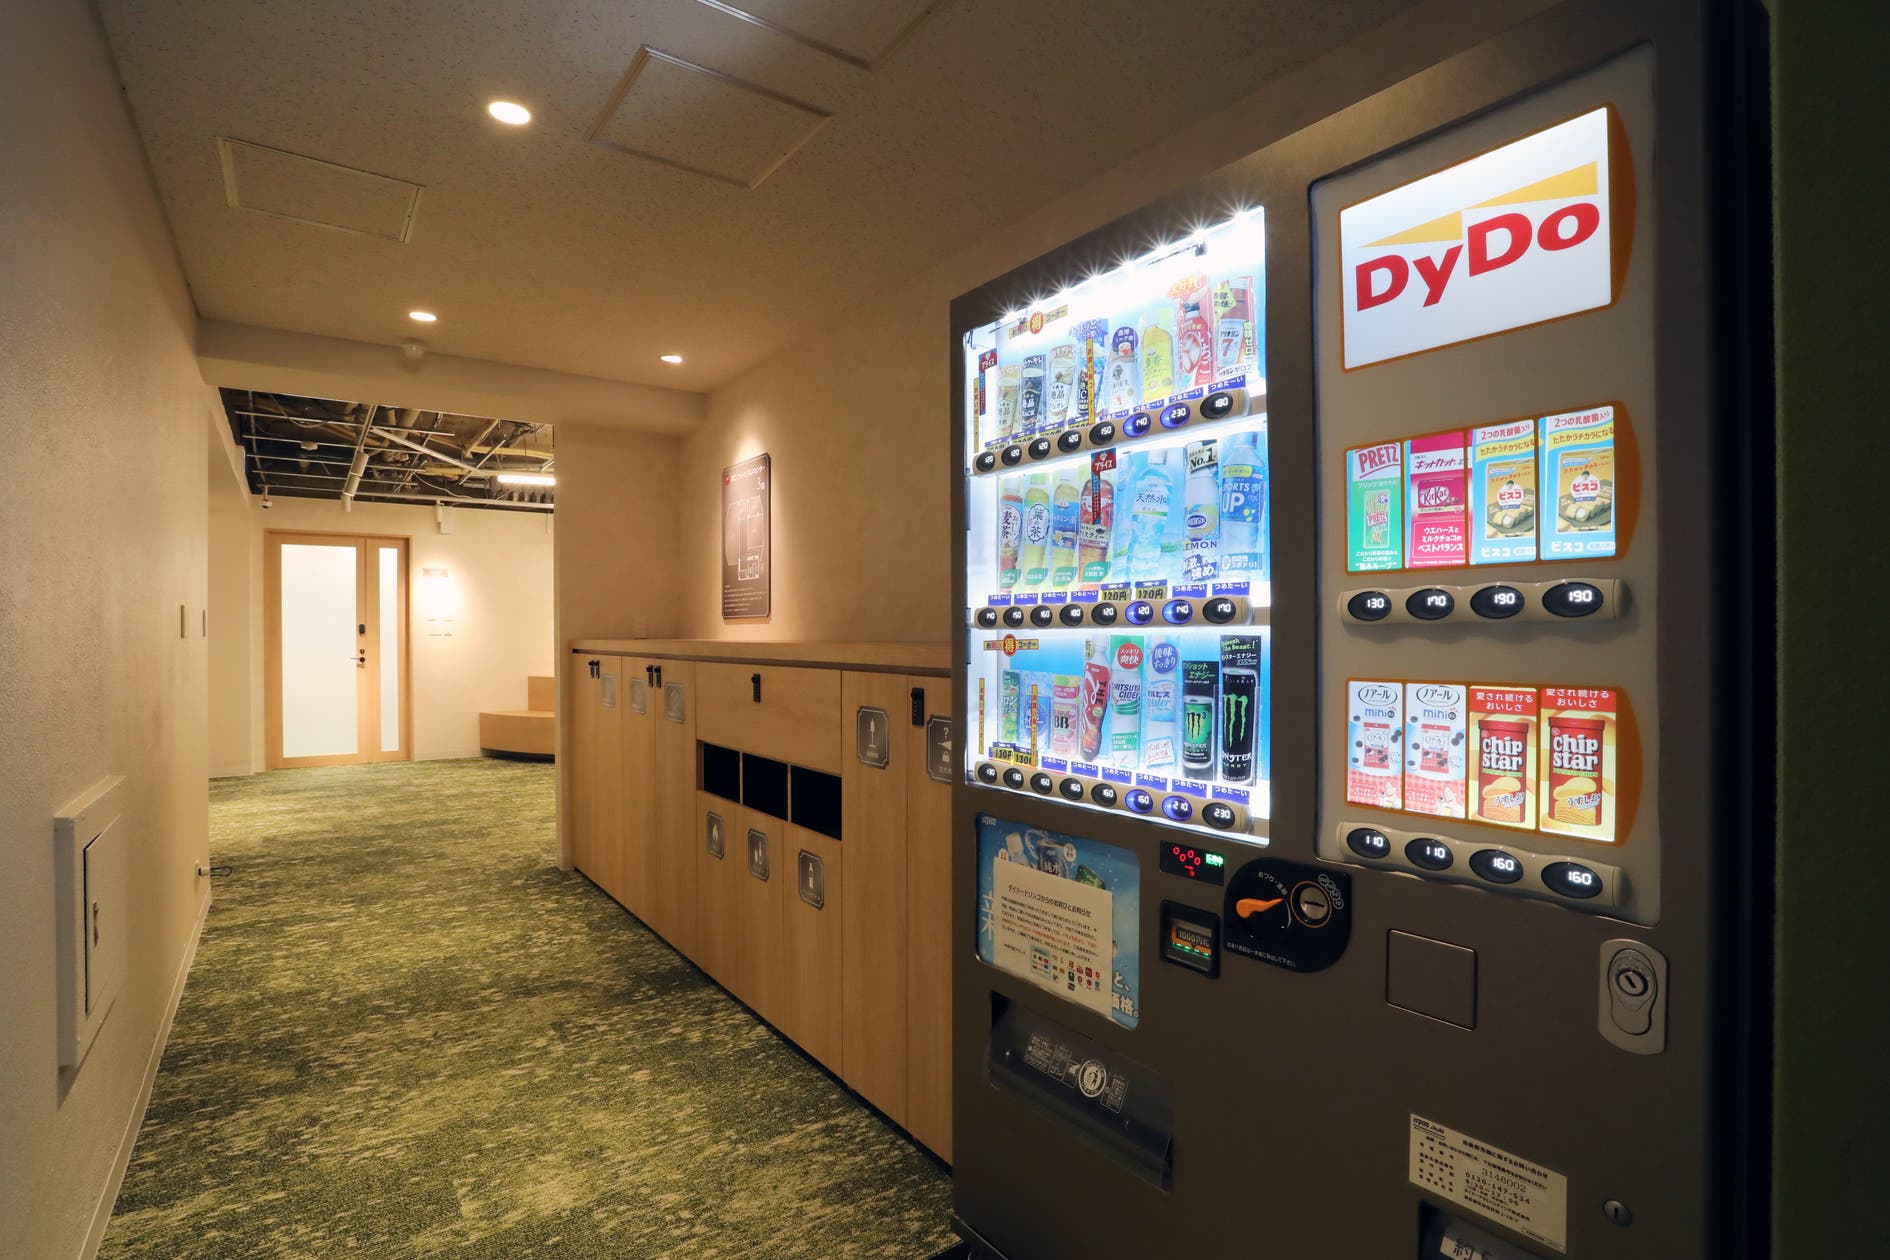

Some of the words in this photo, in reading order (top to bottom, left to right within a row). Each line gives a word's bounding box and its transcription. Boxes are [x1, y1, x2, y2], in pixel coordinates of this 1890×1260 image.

[1355, 202, 1600, 312] DyDo
[1222, 338, 1234, 357] 7
[1215, 397, 1229, 408] 180
[1171, 407, 1187, 418] 230
[1554, 411, 1610, 428] 2つの乳酸菌入り
[1481, 423, 1531, 441] 2つの乳酸菌入り
[1094, 459, 1113, 471] プライス
[1358, 444, 1400, 474] PRETZ
[1415, 457, 1456, 470] キットカット
[1572, 482, 1599, 493] ビスコ
[1136, 492, 1168, 505] 天然水
[1421, 485, 1450, 506] KitKat
[1499, 490, 1523, 501] ビスコ
[1222, 492, 1245, 513] UP
[1368, 513, 1387, 526] PRETZ
[1424, 526, 1460, 534] ウエハースと
[1422, 534, 1463, 543] ミルクチョコの
[1417, 542, 1464, 553] ベストバランス
[1481, 547, 1511, 558] ビスコ
[1551, 541, 1584, 552] ビスコ
[1103, 591, 1127, 601] 120円
[1137, 588, 1164, 600] 120円
[1494, 593, 1516, 605] 190
[1568, 589, 1593, 603] 190
[1367, 597, 1385, 609] 130
[1427, 595, 1447, 607] 170
[1103, 607, 1114, 616] 120
[1137, 605, 1150, 615] 120
[1217, 603, 1232, 613] 170
[1153, 645, 1173, 657] 後味
[1153, 656, 1177, 669] すっきり
[1364, 688, 1391, 700] ノアール
[1423, 688, 1453, 701] ノアール
[1475, 691, 1534, 704] 愛され続ける
[1545, 688, 1611, 700] 愛され続ける
[1485, 702, 1523, 712] おいしさ
[1556, 698, 1599, 709] おいしさ
[1364, 707, 1387, 719] mini
[1423, 708, 1448, 720] mini
[1482, 752, 1523, 772] star
[1552, 750, 1599, 771] star
[1214, 808, 1232, 820] 230
[1365, 835, 1384, 848] 110
[1426, 846, 1446, 858] 110
[1493, 857, 1515, 872] 160
[1568, 871, 1593, 885] 160
